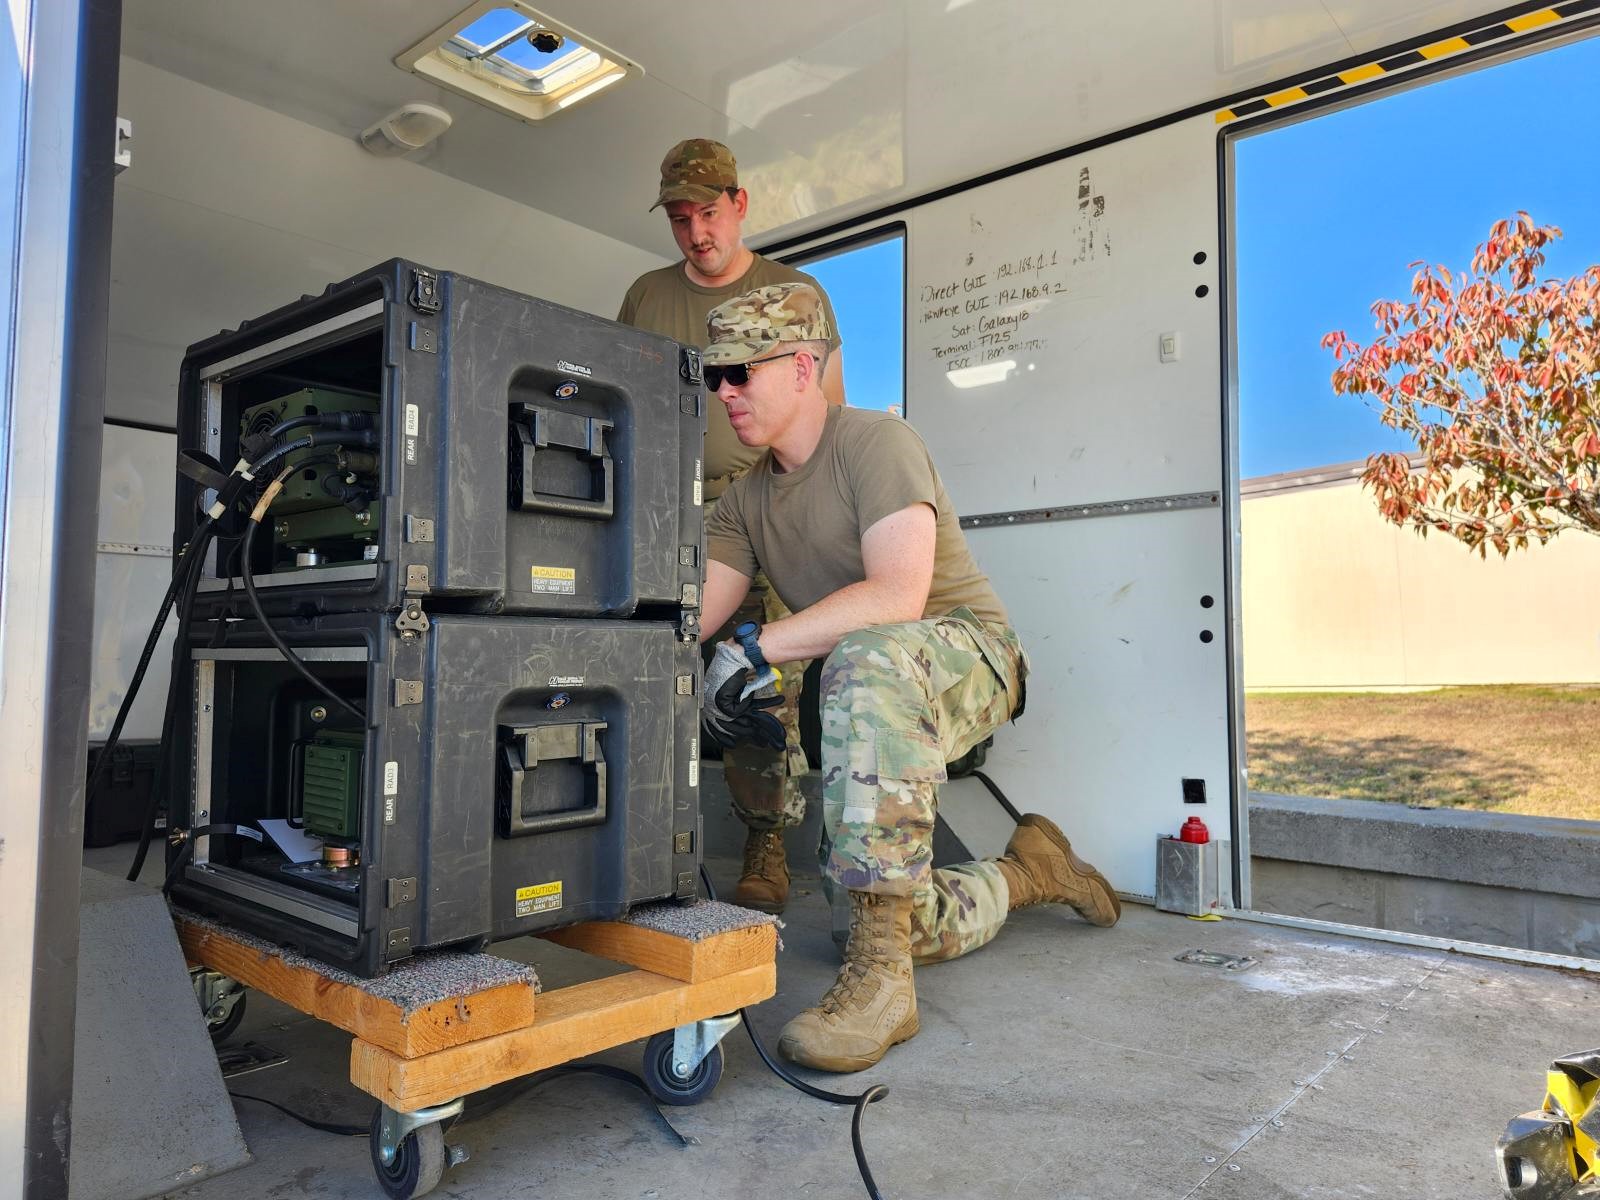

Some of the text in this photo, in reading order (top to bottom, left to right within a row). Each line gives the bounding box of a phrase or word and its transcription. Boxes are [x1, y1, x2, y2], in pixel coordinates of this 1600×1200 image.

[963, 274, 987, 293] GUI
[965, 296, 990, 314] GUI
[407, 439, 415, 461] REAR
[540, 569, 573, 578] CAUTION
[385, 798, 394, 822] REAR
[524, 883, 560, 897] CAUTION
